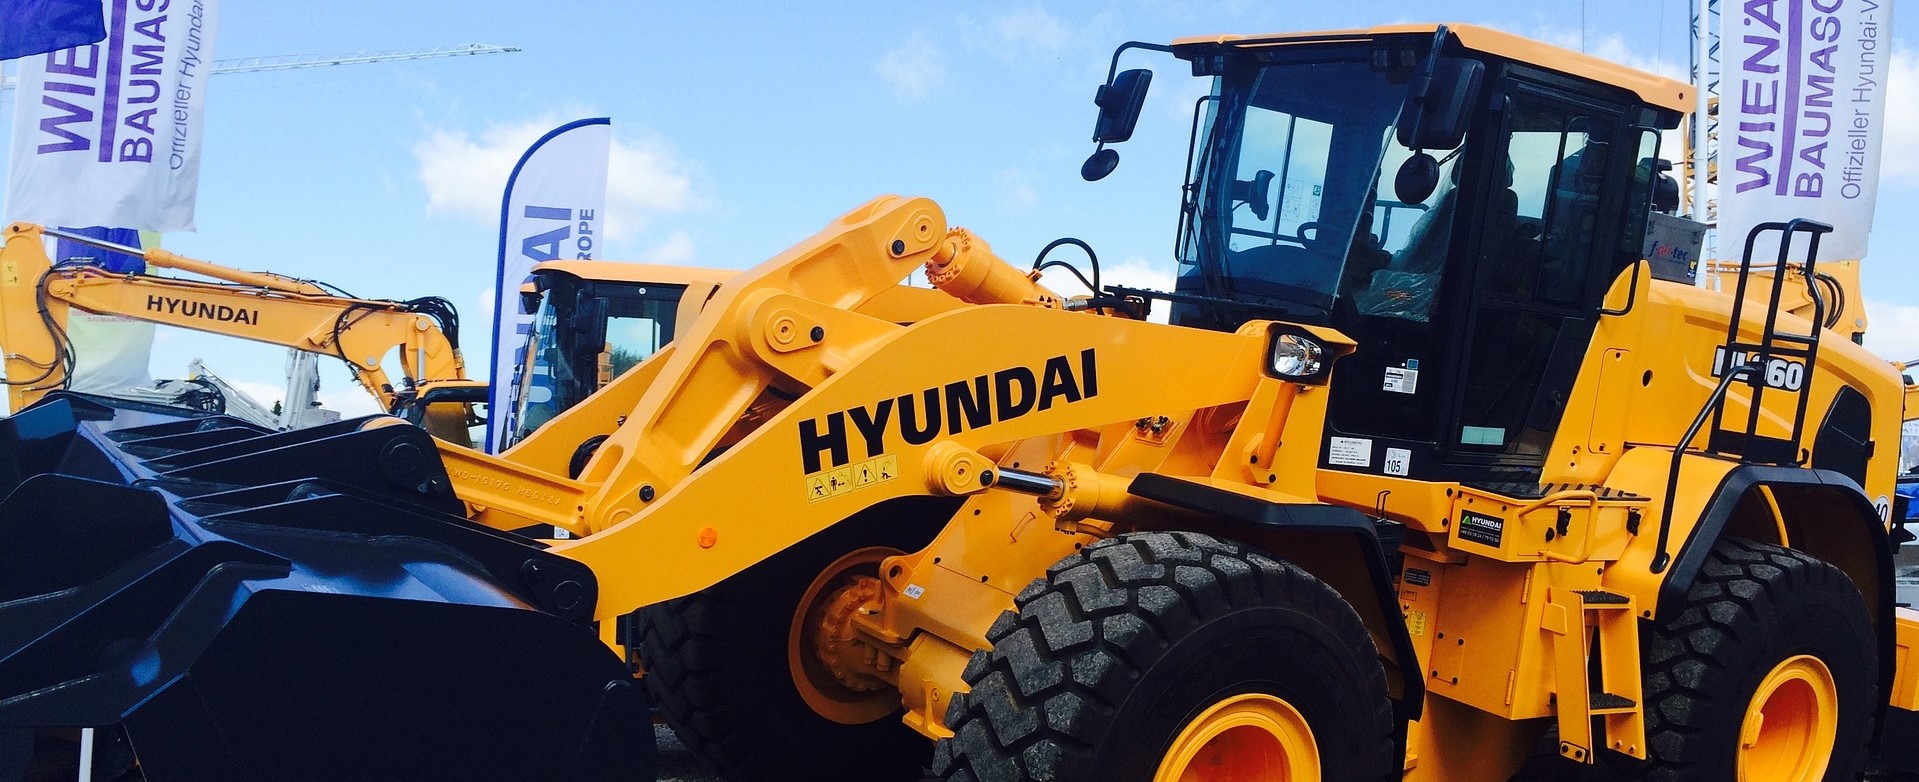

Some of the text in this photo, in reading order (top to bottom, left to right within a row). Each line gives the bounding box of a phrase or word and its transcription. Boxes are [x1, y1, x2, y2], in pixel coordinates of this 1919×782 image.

[37, 44, 99, 155] WIE
[1841, 109, 1869, 199] Offizieller
[576, 208, 595, 260] ROPE
[147, 295, 258, 325] HYUNDAI
[798, 348, 1098, 475] HYUNDAI
[1387, 459, 1402, 473] 105
[1471, 516, 1501, 528] HYUNDAI
